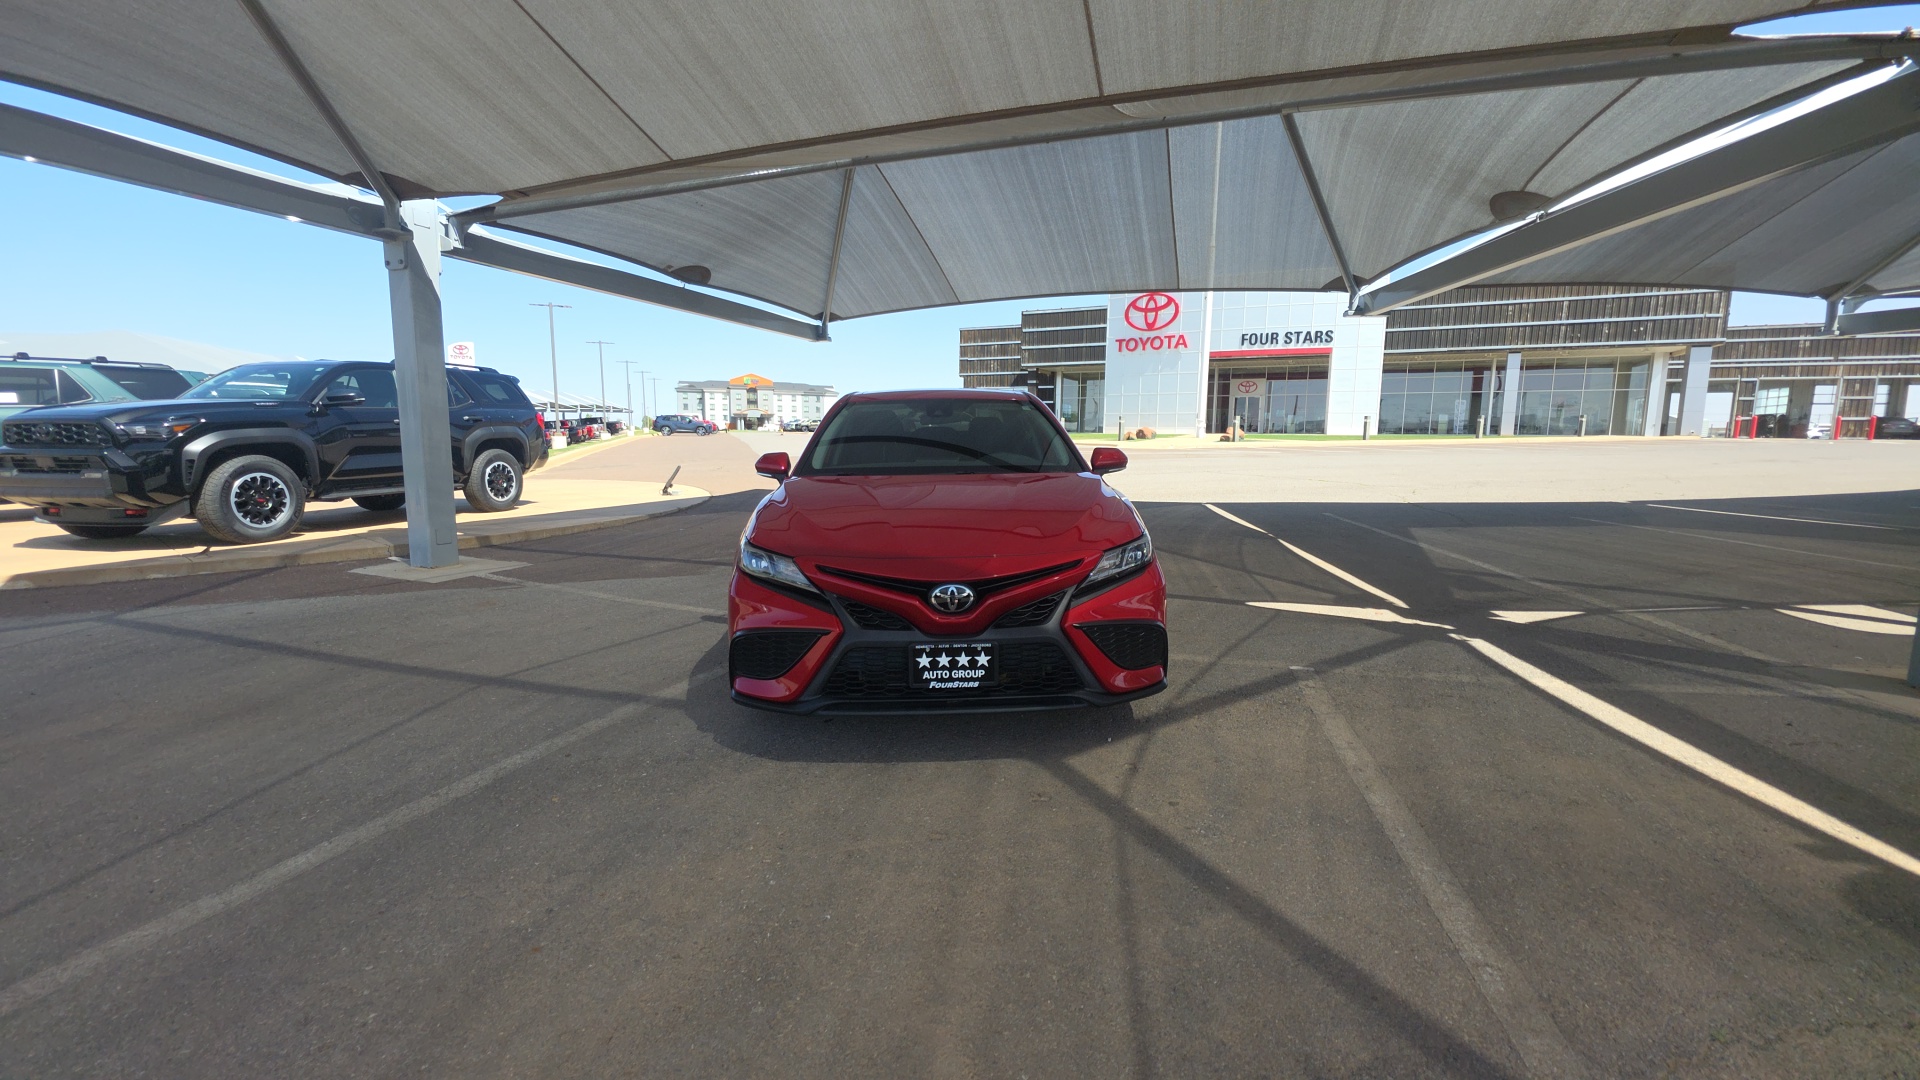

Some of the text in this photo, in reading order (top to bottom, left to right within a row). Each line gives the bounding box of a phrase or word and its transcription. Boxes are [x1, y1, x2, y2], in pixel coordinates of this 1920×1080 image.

[1115, 334, 1188, 353] TOYOTA
[1240, 329, 1334, 347] FOUR STARS
[922, 669, 985, 679] AUTO GROUP
